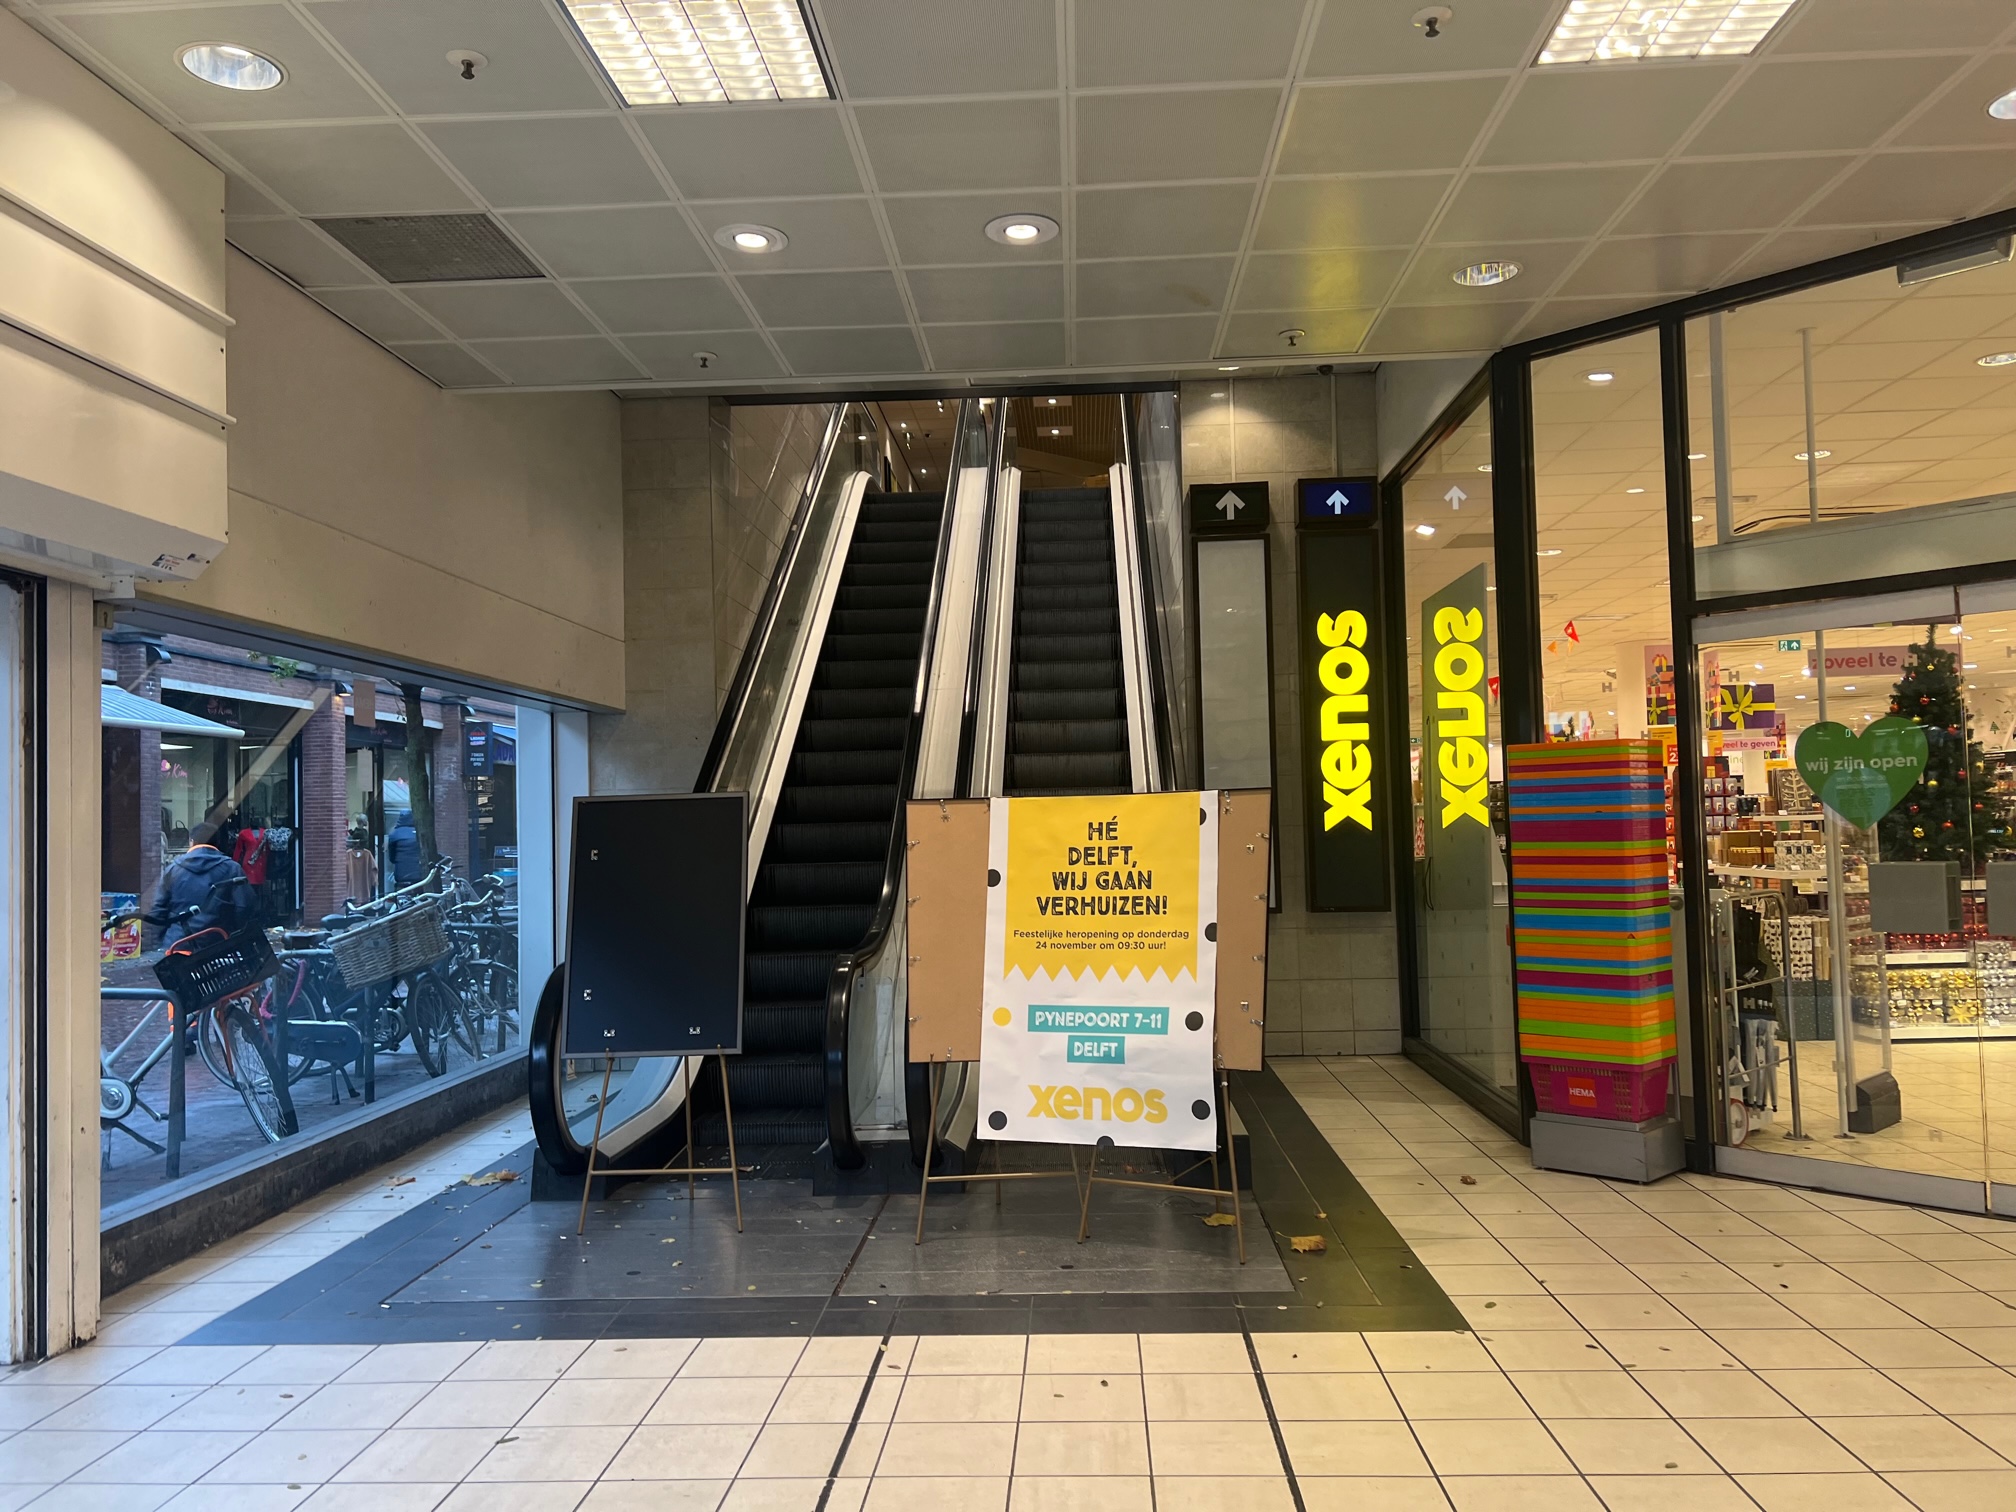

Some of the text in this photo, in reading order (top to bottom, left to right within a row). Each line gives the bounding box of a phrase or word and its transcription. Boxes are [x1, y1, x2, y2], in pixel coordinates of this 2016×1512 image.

[1878, 653, 1898, 667] te
[1317, 610, 1373, 831] xenos
[1740, 740, 1749, 748] te
[1751, 741, 1776, 749] geven
[1805, 755, 1918, 774] wij zijn open
[1088, 816, 1118, 840] HÉ
[1068, 846, 1138, 868] DELFT,
[1052, 871, 1152, 891] WIJ GAAN
[1036, 896, 1168, 916] VERHUIZEN!
[1013, 929, 1189, 940] Feestelijke heropening op donderdag
[1035, 941, 1048, 950] 24
[1050, 941, 1096, 950] november
[1117, 941, 1145, 950] 09:30
[1148, 941, 1166, 950] uur!
[1034, 1011, 1163, 1029] PYNEPOORT 7-11
[1073, 1041, 1119, 1057] DELFT
[1569, 1088, 1596, 1098] HEMA
[1027, 1085, 1168, 1124] xenos
